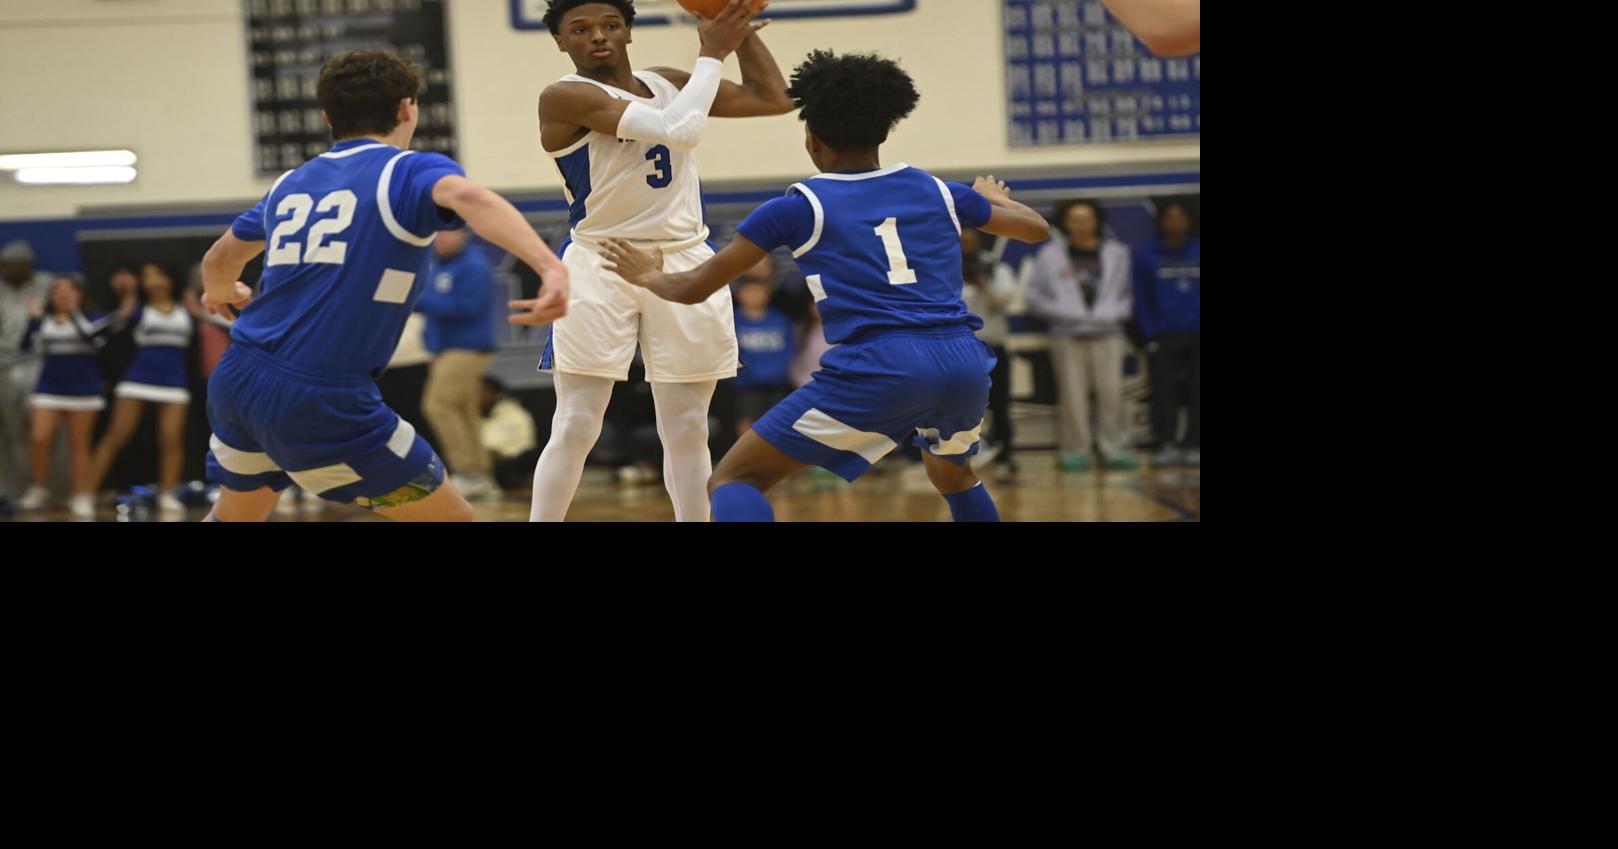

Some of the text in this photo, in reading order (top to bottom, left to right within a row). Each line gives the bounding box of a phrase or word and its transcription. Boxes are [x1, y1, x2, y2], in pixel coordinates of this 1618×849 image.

[645, 144, 673, 189] 3
[267, 190, 357, 267] 22
[874, 217, 917, 285] 1
